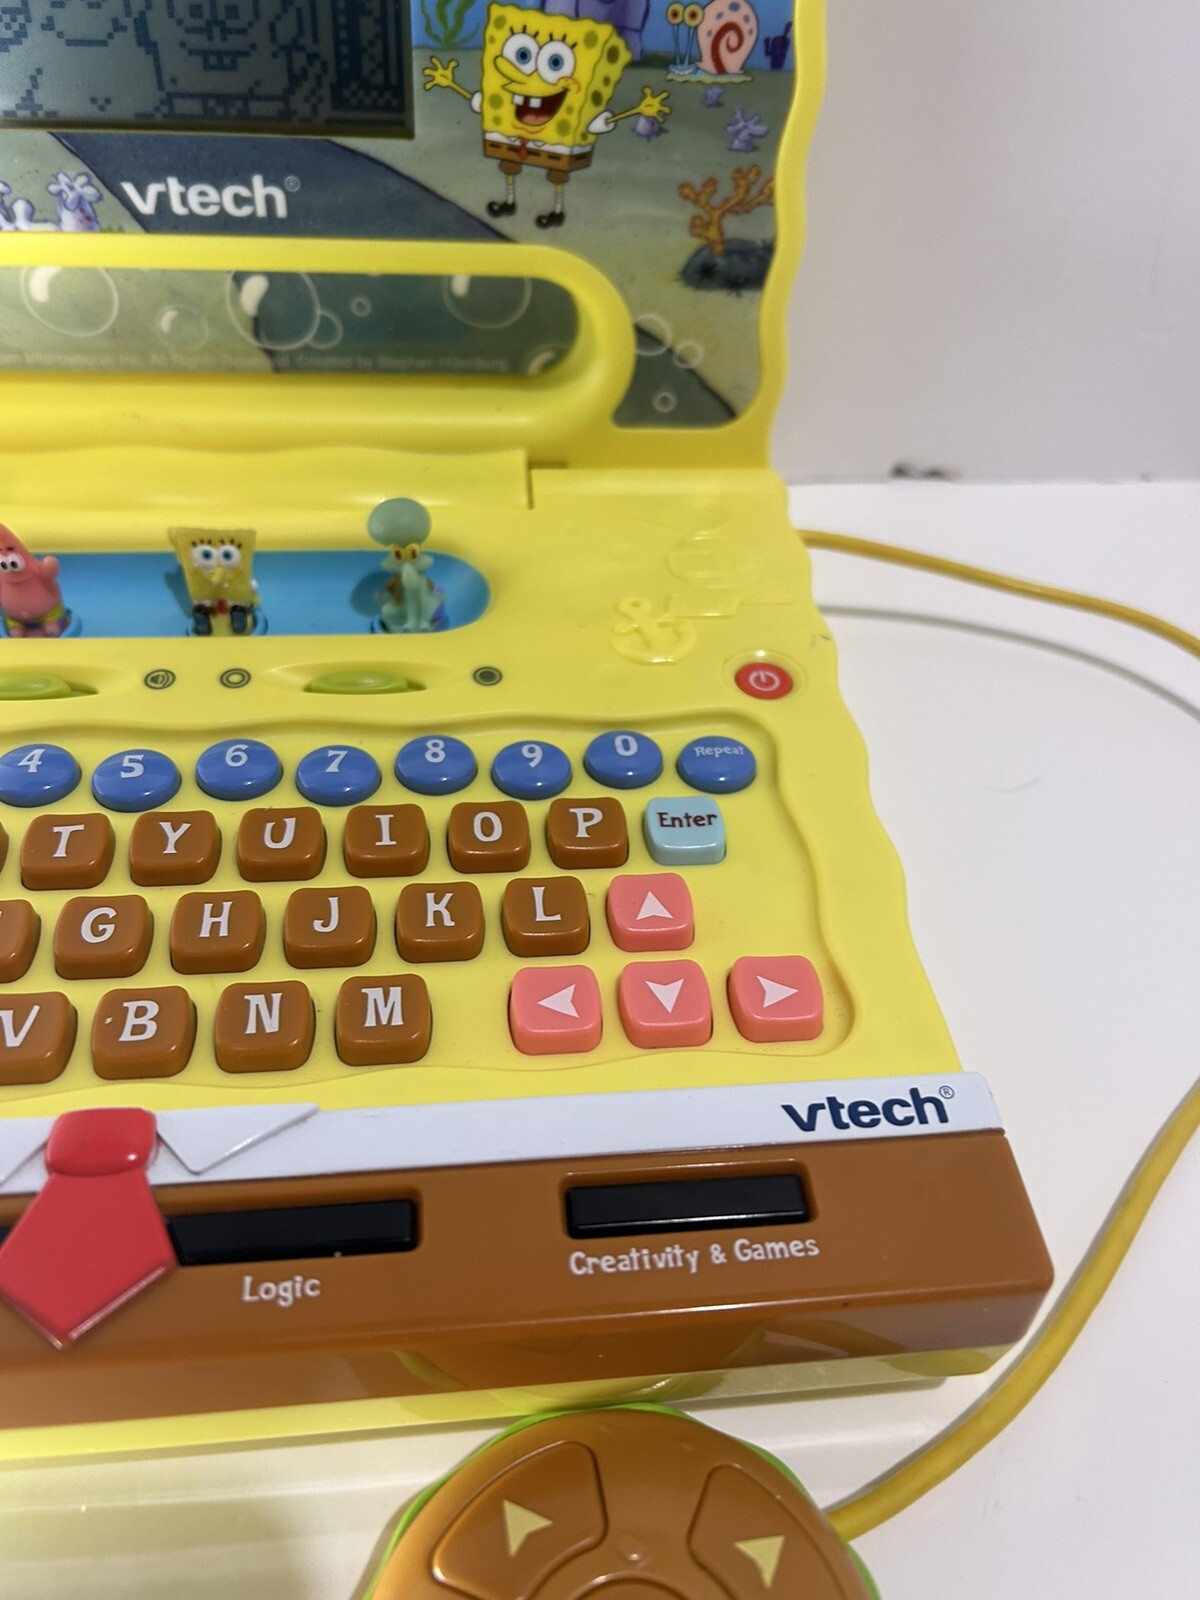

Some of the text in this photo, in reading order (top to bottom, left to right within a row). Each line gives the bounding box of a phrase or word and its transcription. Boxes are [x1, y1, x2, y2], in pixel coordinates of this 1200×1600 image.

[17, 748, 46, 773] 4
[120, 754, 145, 778] 5
[225, 744, 249, 767] 6
[324, 750, 348, 773] 7
[425, 739, 446, 763] 8
[522, 744, 543, 768] 9
[694, 745, 744, 758] Repeat
[52, 807, 717, 858] T Y U I O P Enter
[80, 887, 561, 943] G H J K L
[0, 986, 404, 1047] V B N M
[569, 1237, 820, 1275] Creativity & Games
[241, 1275, 321, 1307] Logic
